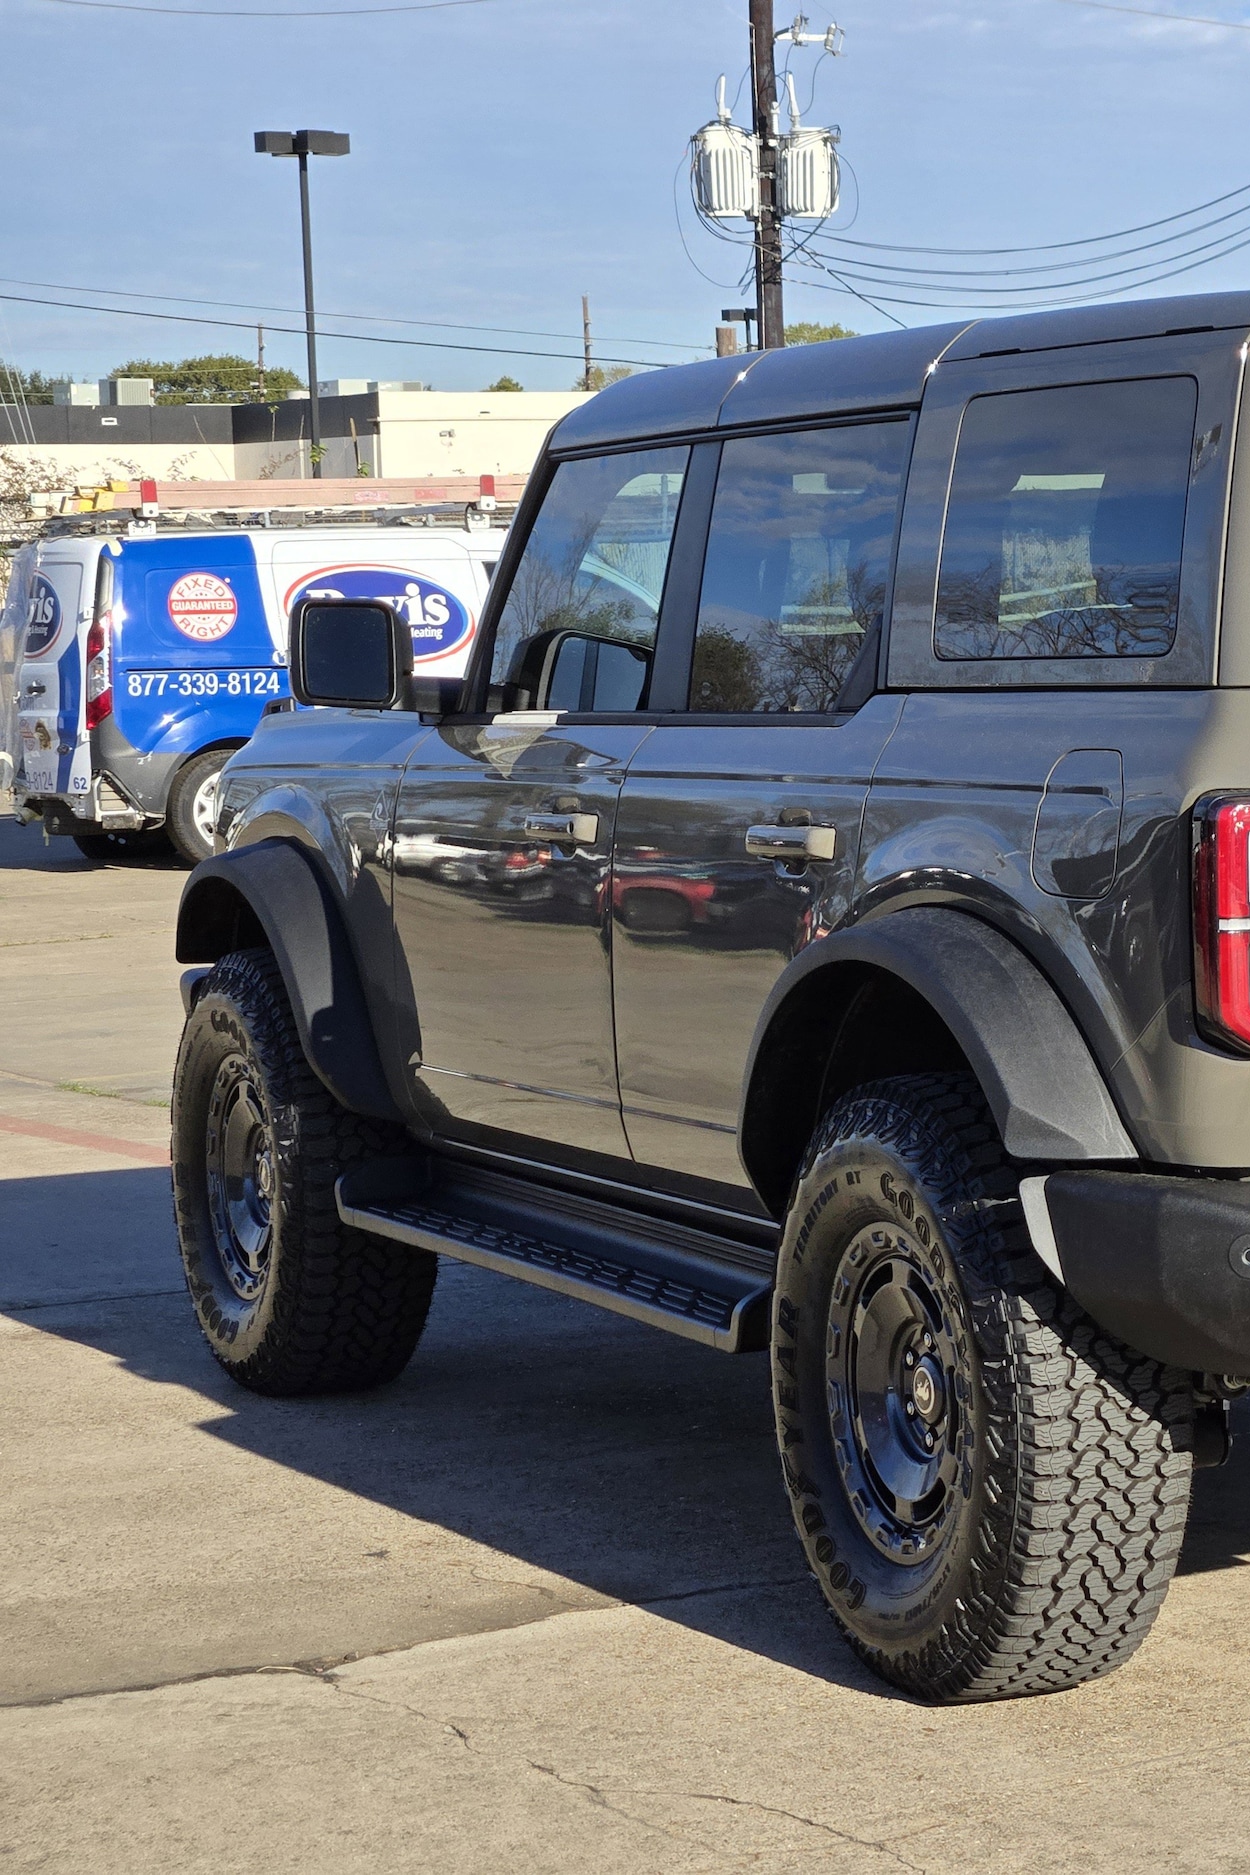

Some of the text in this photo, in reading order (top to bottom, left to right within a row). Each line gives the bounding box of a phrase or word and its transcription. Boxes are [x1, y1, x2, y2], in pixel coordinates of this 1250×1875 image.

[176, 577, 226, 597] FIXED
[171, 600, 234, 611] GUARANTEED
[179, 615, 229, 637] RIGHT
[128, 672, 280, 697] 877-339-8124
[73, 777, 88, 790] 62
